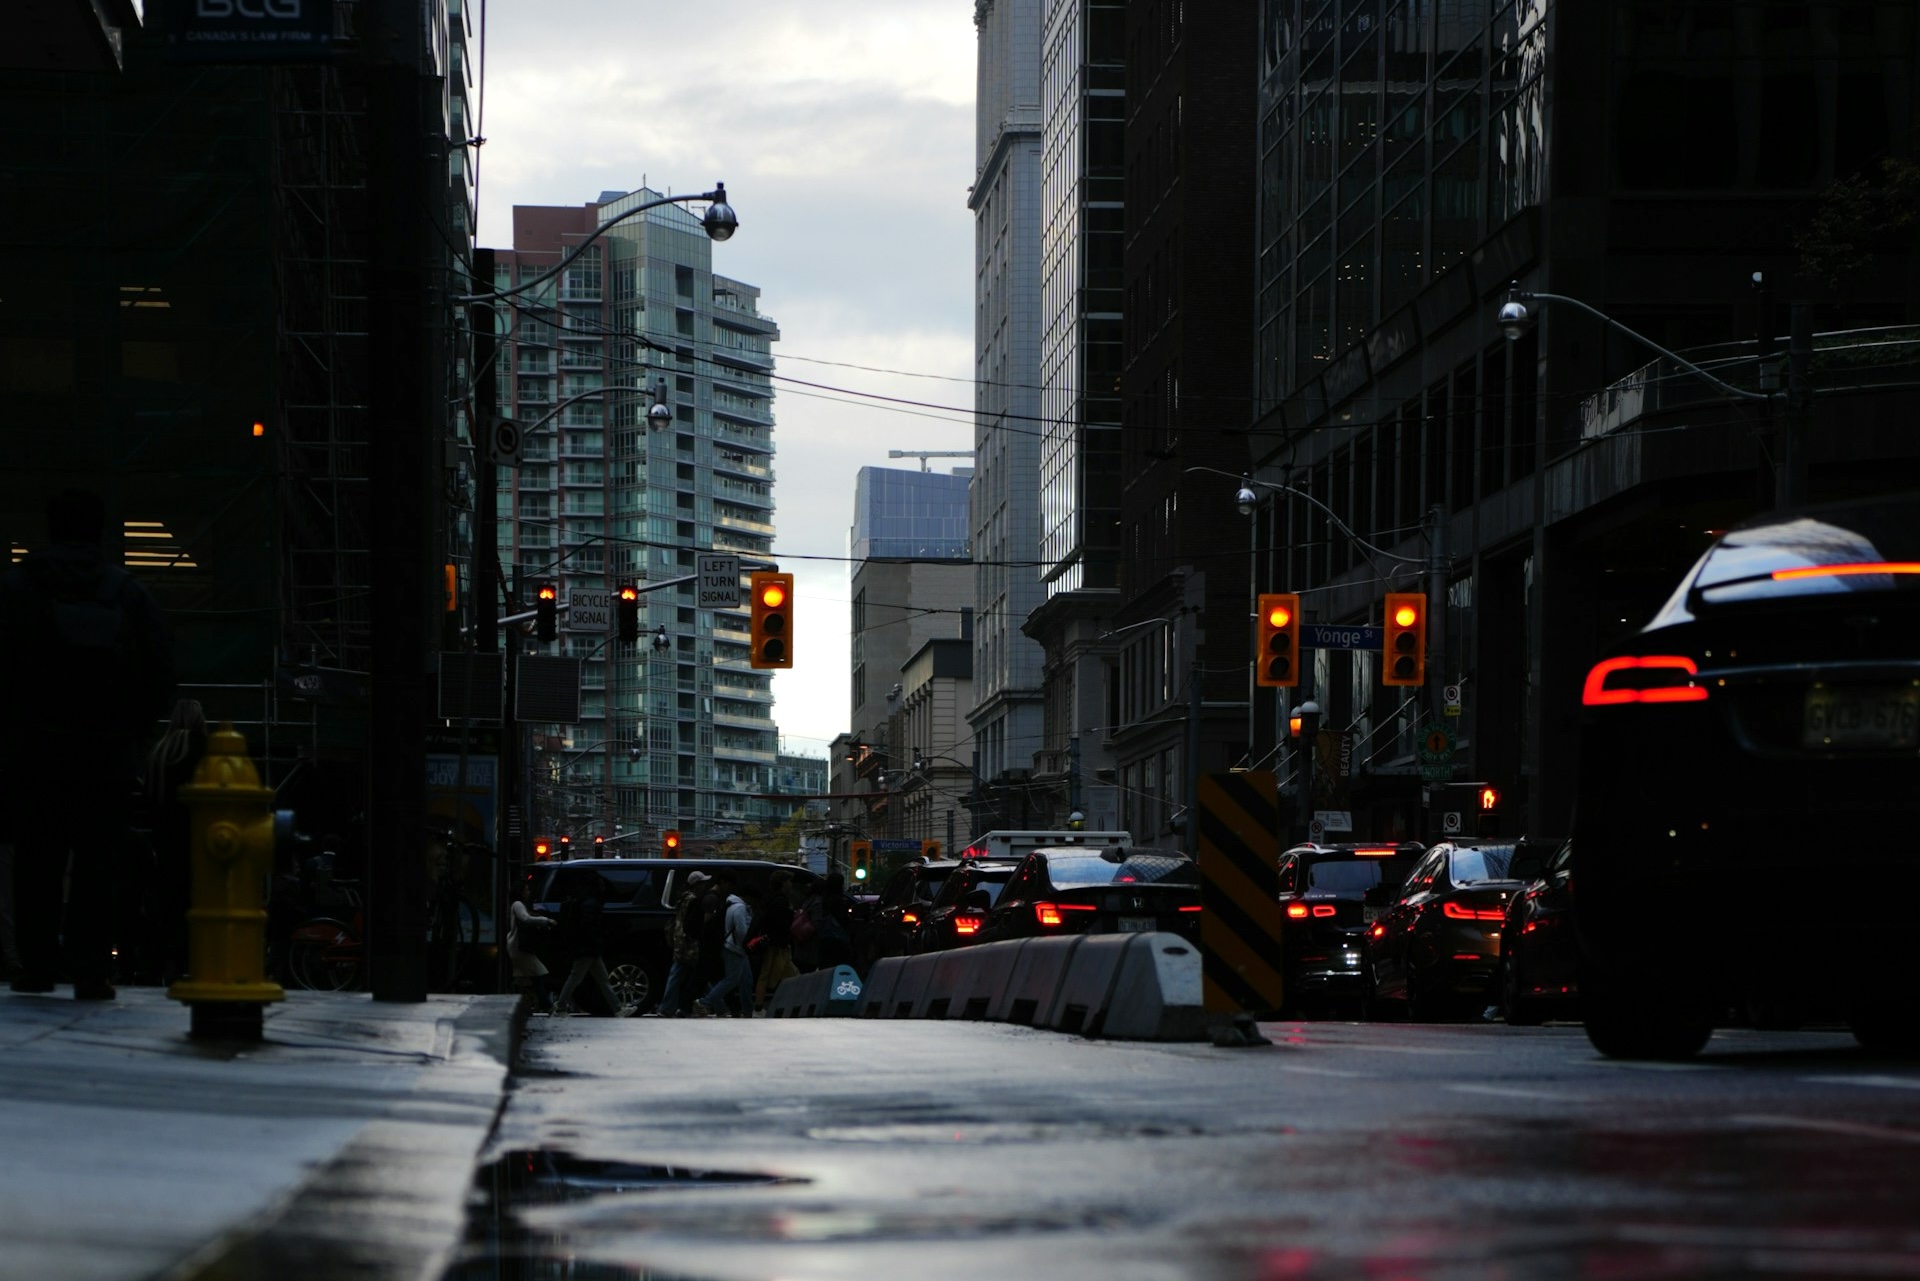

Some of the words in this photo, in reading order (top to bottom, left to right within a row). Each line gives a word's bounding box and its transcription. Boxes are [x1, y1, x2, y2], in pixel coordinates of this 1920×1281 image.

[185, 31, 248, 41] CANADA'S
[251, 31, 278, 41] LAW
[280, 31, 312, 41] FIRM
[704, 561, 734, 572] LEFT
[704, 576, 735, 587] TURN
[572, 594, 609, 608] BICYCLE
[702, 591, 738, 602] SIGNAL
[573, 611, 607, 624] SIGNAL
[1314, 627, 1361, 648] Yonge
[1364, 629, 1373, 638] St
[1340, 735, 1351, 777] BEAUTY
[1424, 766, 1450, 778] NORTH
[880, 841, 909, 849] Victoria
